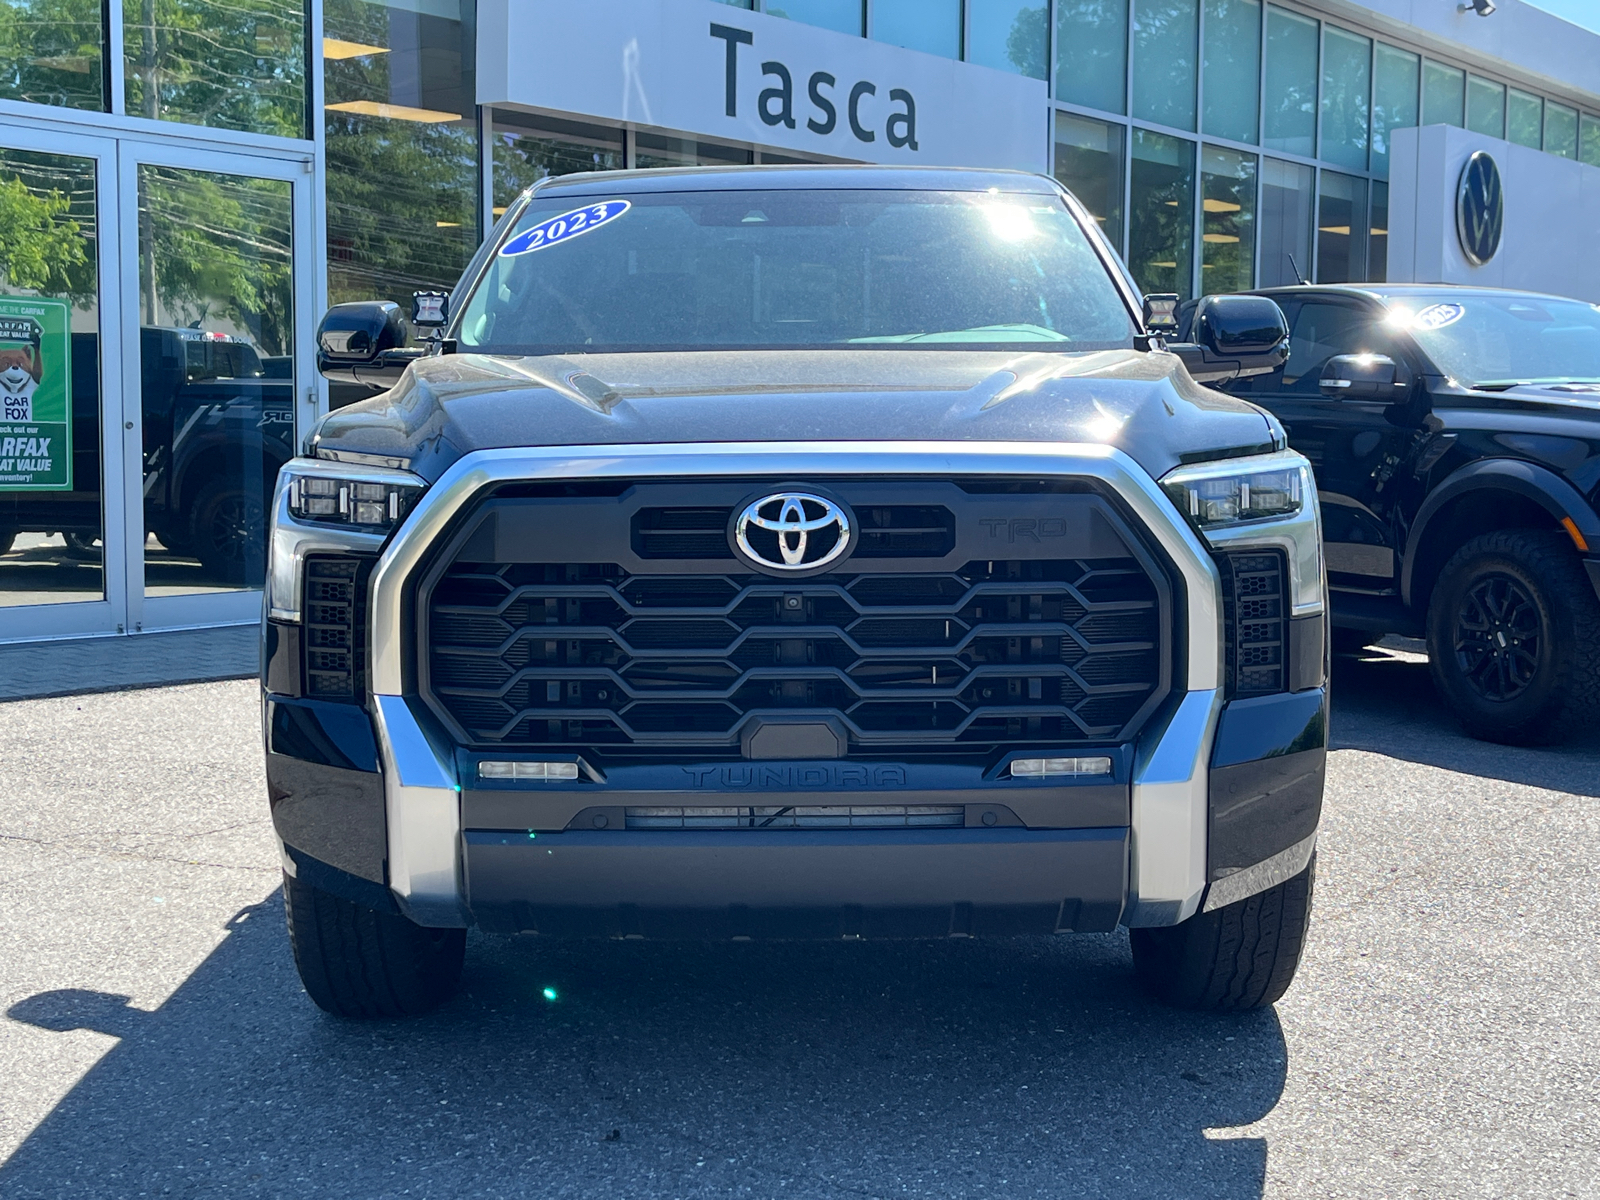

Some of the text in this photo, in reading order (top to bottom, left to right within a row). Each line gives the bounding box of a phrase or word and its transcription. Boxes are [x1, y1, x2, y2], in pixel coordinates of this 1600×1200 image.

[709, 21, 919, 152] Tasca
[525, 204, 608, 251] 2023
[20, 306, 46, 316] CARFAX
[0, 322, 31, 331] ARFAX
[0, 330, 31, 339] EAT VALUE
[4, 396, 29, 407] CAR
[5, 407, 28, 420] FOX
[0, 425, 13, 434] eck
[13, 426, 26, 434] out
[0, 437, 52, 457] RFAX
[16, 459, 52, 472] VALUE
[0, 473, 33, 483] nventory!
[979, 518, 1067, 543] TRD
[682, 765, 906, 788] TUNDRA
